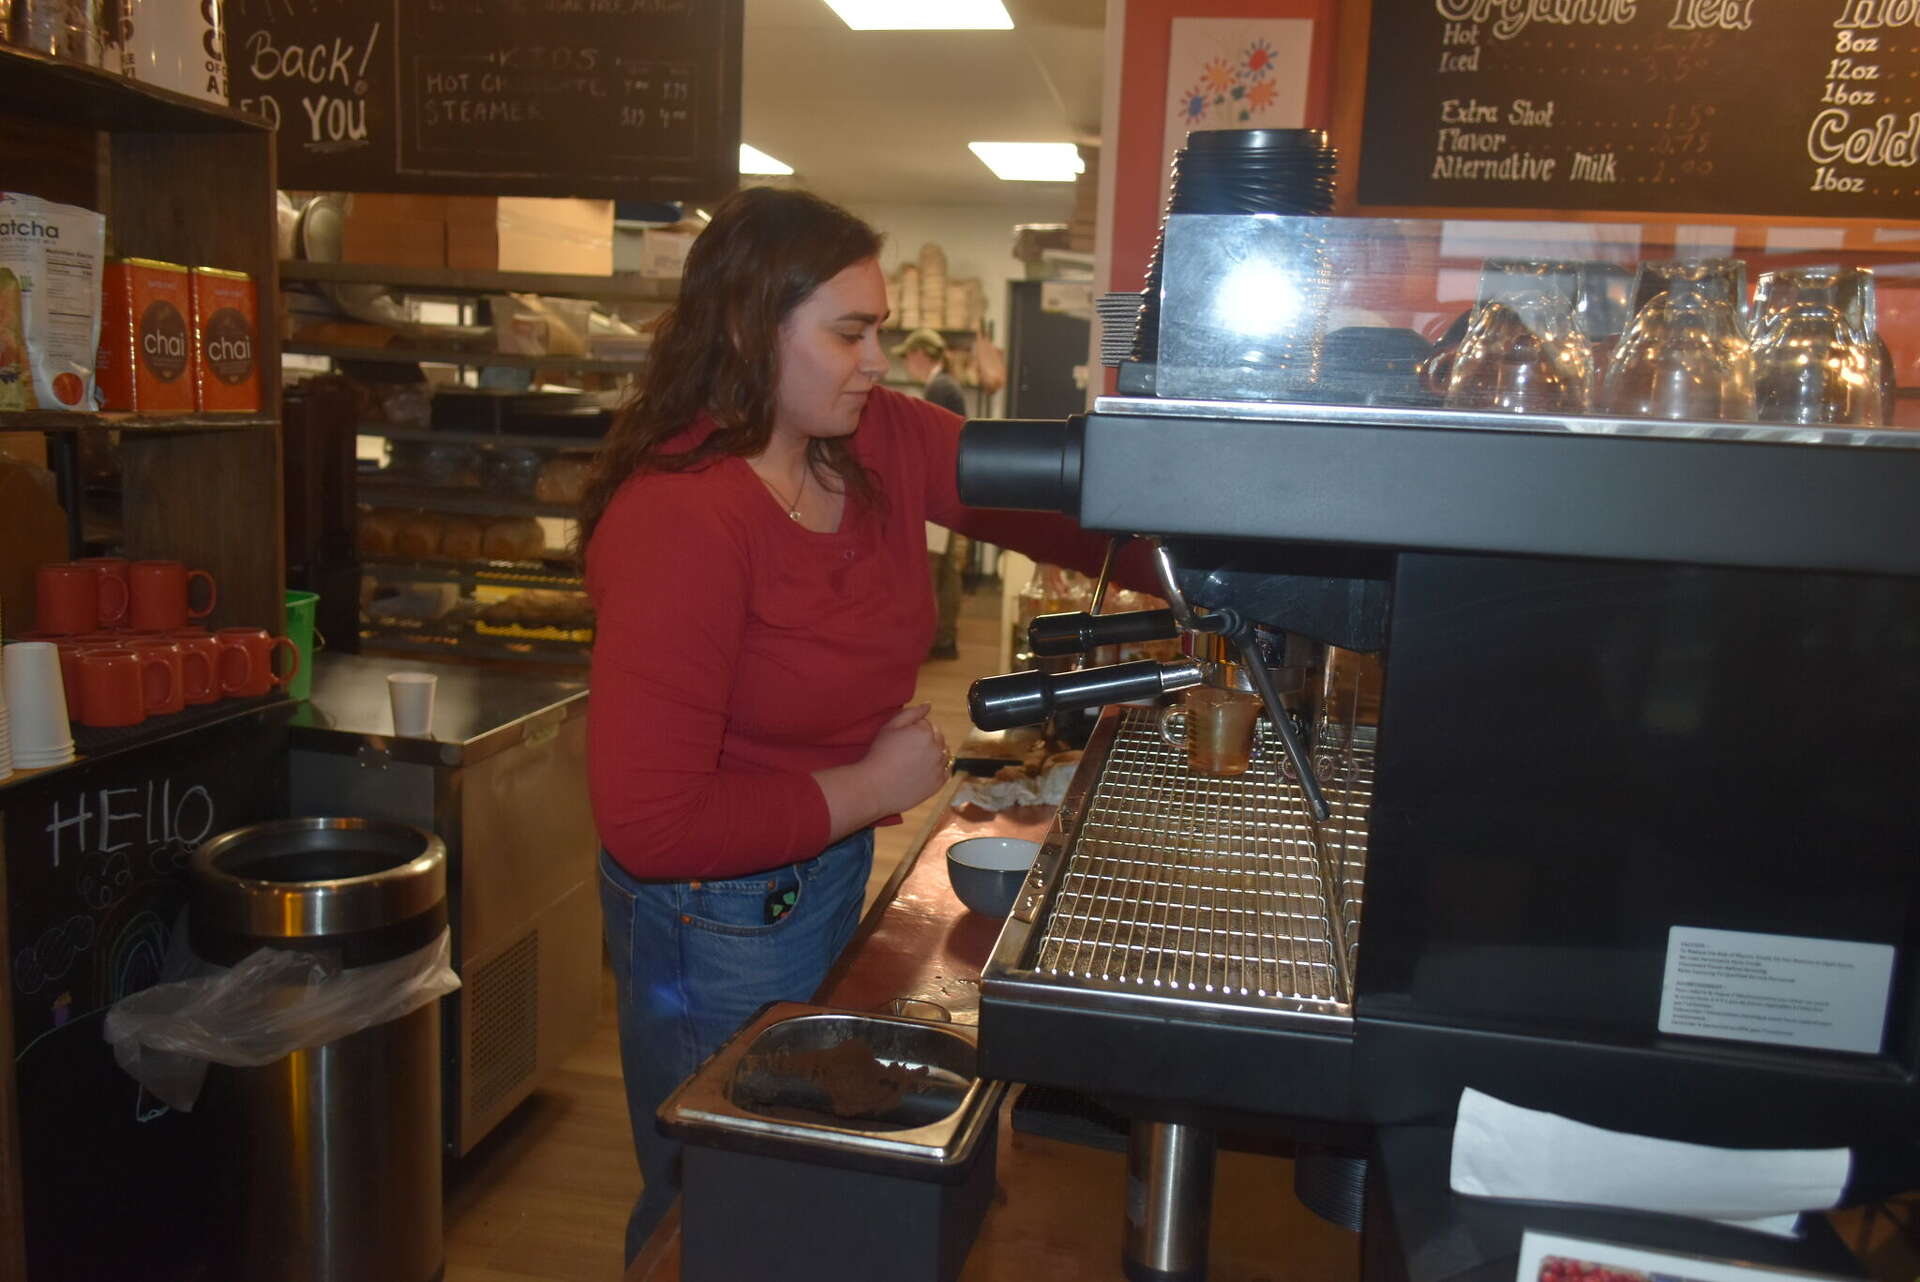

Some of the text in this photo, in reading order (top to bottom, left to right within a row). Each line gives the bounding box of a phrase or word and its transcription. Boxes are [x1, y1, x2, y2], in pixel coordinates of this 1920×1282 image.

[1442, 22, 1481, 46] Hot
[1835, 29, 1880, 53] 8oz
[246, 22, 380, 96] Back!
[499, 48, 601, 71] KIDS
[1439, 47, 1481, 73] Iced
[1825, 58, 1880, 80] 12oz
[426, 73, 470, 95] HOT
[1820, 82, 1877, 105] 16oz
[1441, 99, 1499, 124] Extra
[1508, 99, 1555, 128] Shot
[1437, 128, 1506, 153] Flavor
[1807, 108, 1920, 167] Cold
[1431, 152, 1557, 182] Alternative
[1569, 152, 1618, 183] Milk
[1810, 166, 1865, 193] 16oz
[0, 219, 60, 240] atcha
[143, 329, 185, 357] chai
[207, 335, 251, 361] chai
[46, 779, 214, 867] HELLO
